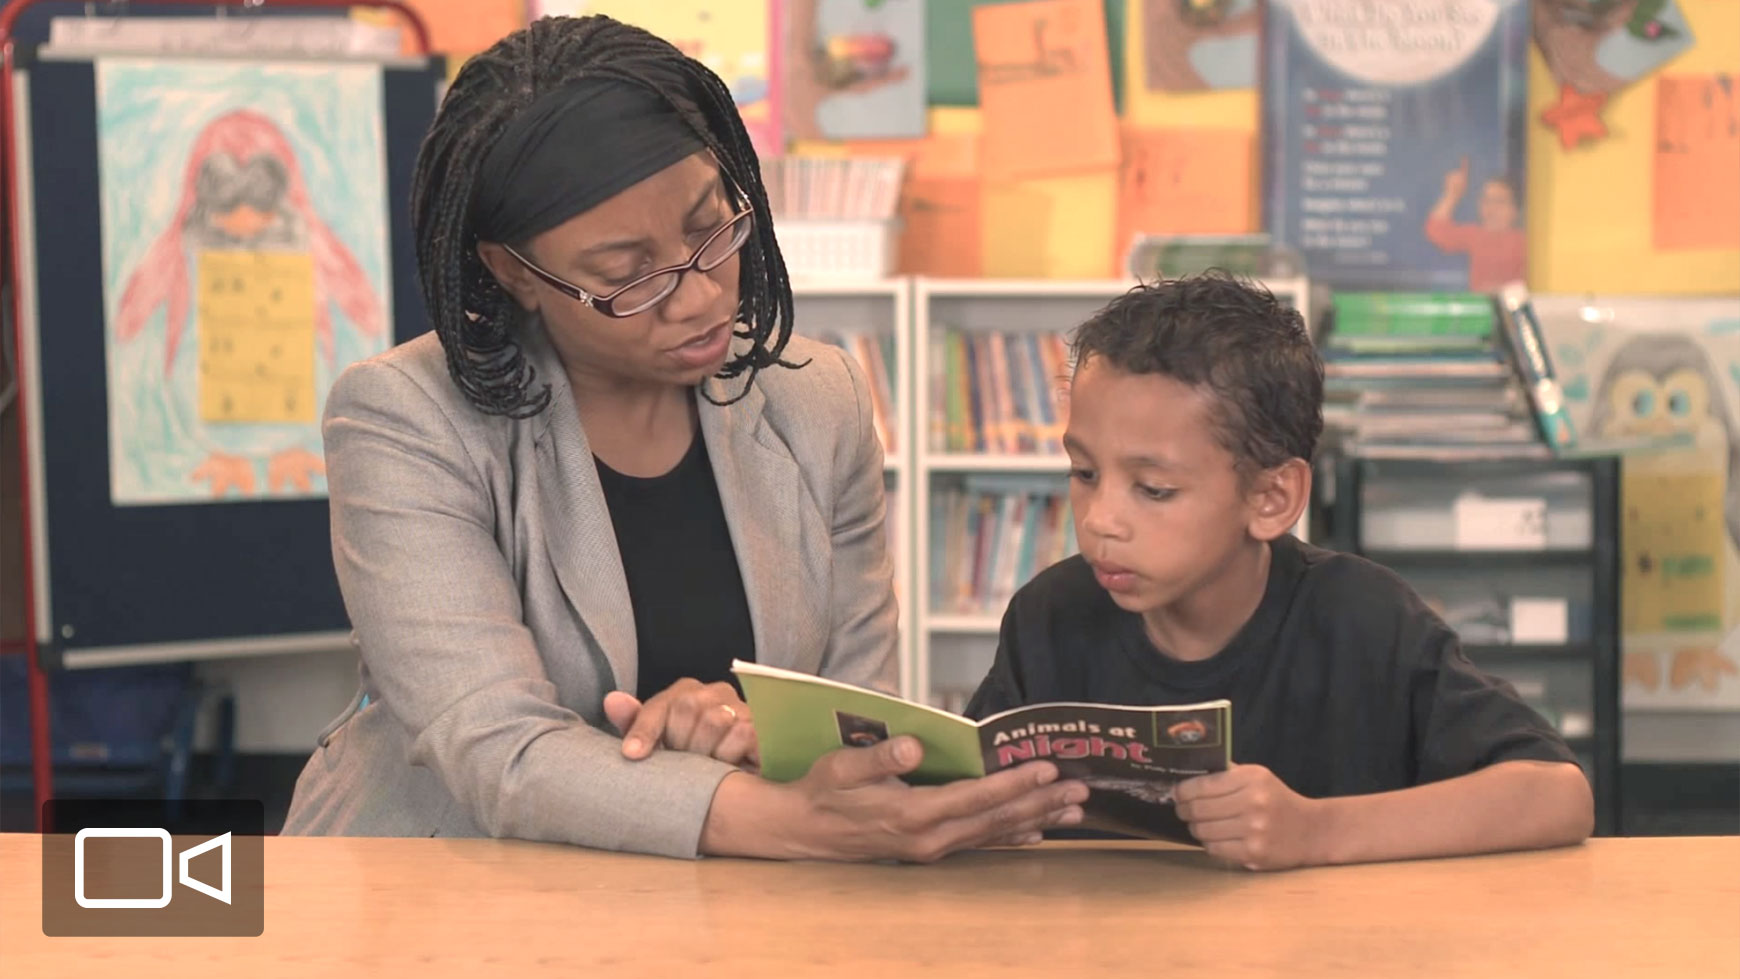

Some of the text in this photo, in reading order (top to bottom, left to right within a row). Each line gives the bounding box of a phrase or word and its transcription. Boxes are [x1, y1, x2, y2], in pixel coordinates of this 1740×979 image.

[993, 719, 1136, 746] Animals at
[997, 734, 1152, 767] Night
